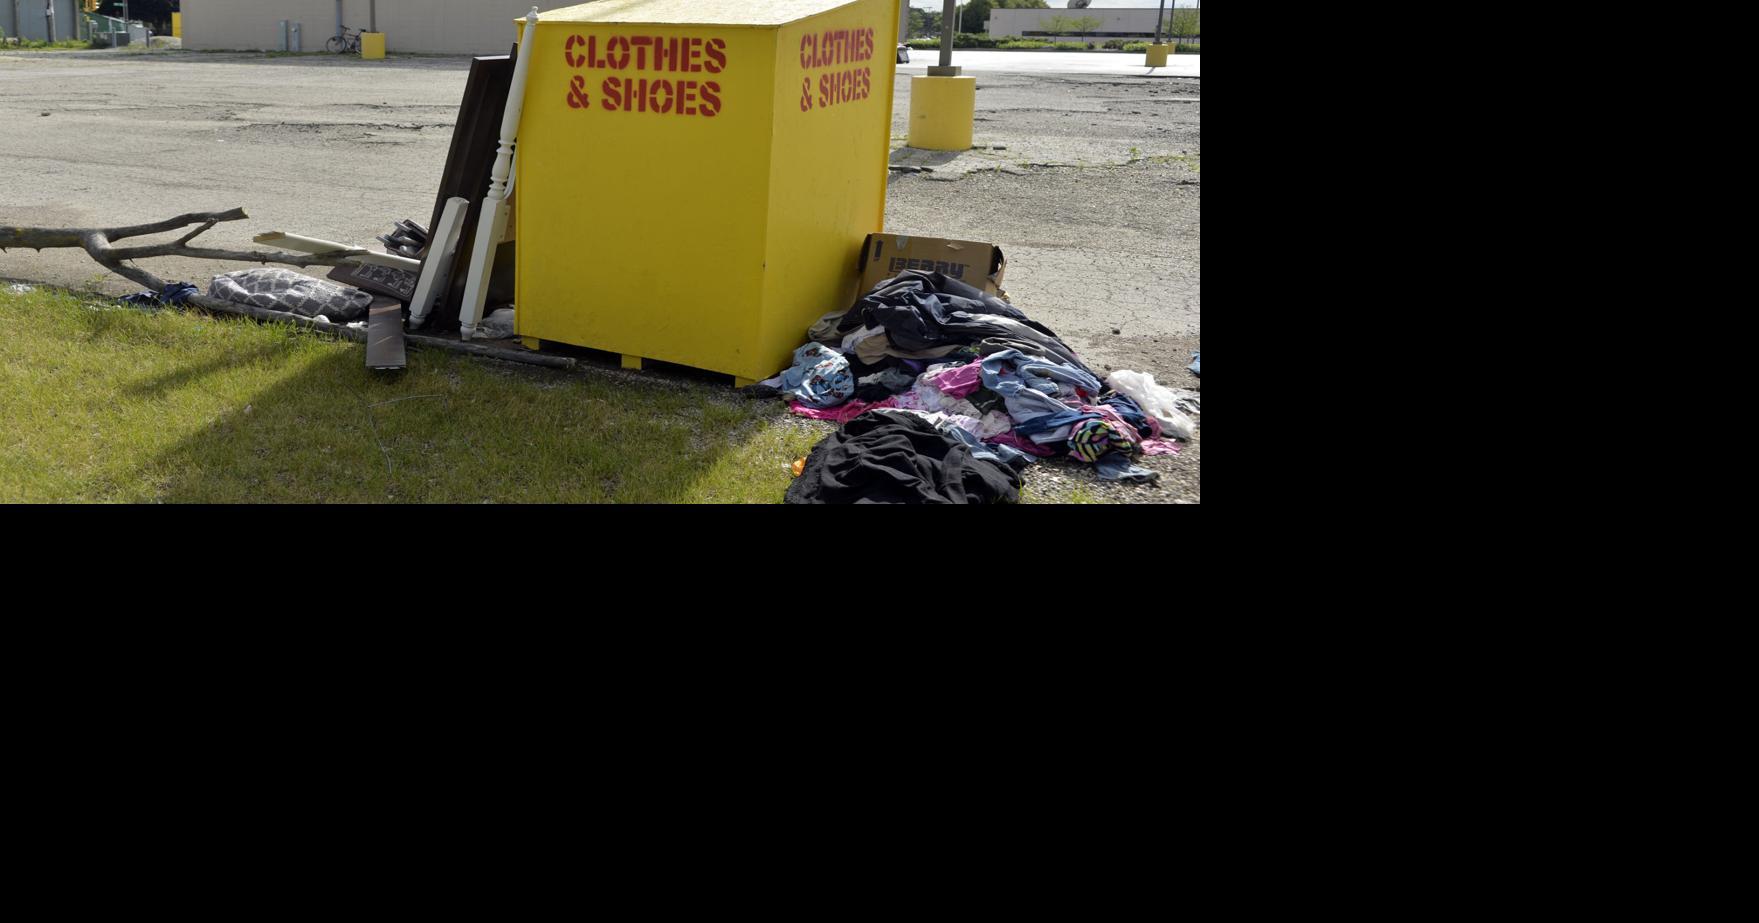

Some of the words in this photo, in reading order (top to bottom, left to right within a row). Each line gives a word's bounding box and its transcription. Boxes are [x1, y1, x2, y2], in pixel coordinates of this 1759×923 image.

[564, 34, 727, 74] CLOTHES
[800, 27, 874, 70] CLOTHES
[566, 75, 591, 110] &
[601, 76, 722, 118] SHOES
[800, 77, 813, 112] &
[819, 68, 871, 108] SHOES
